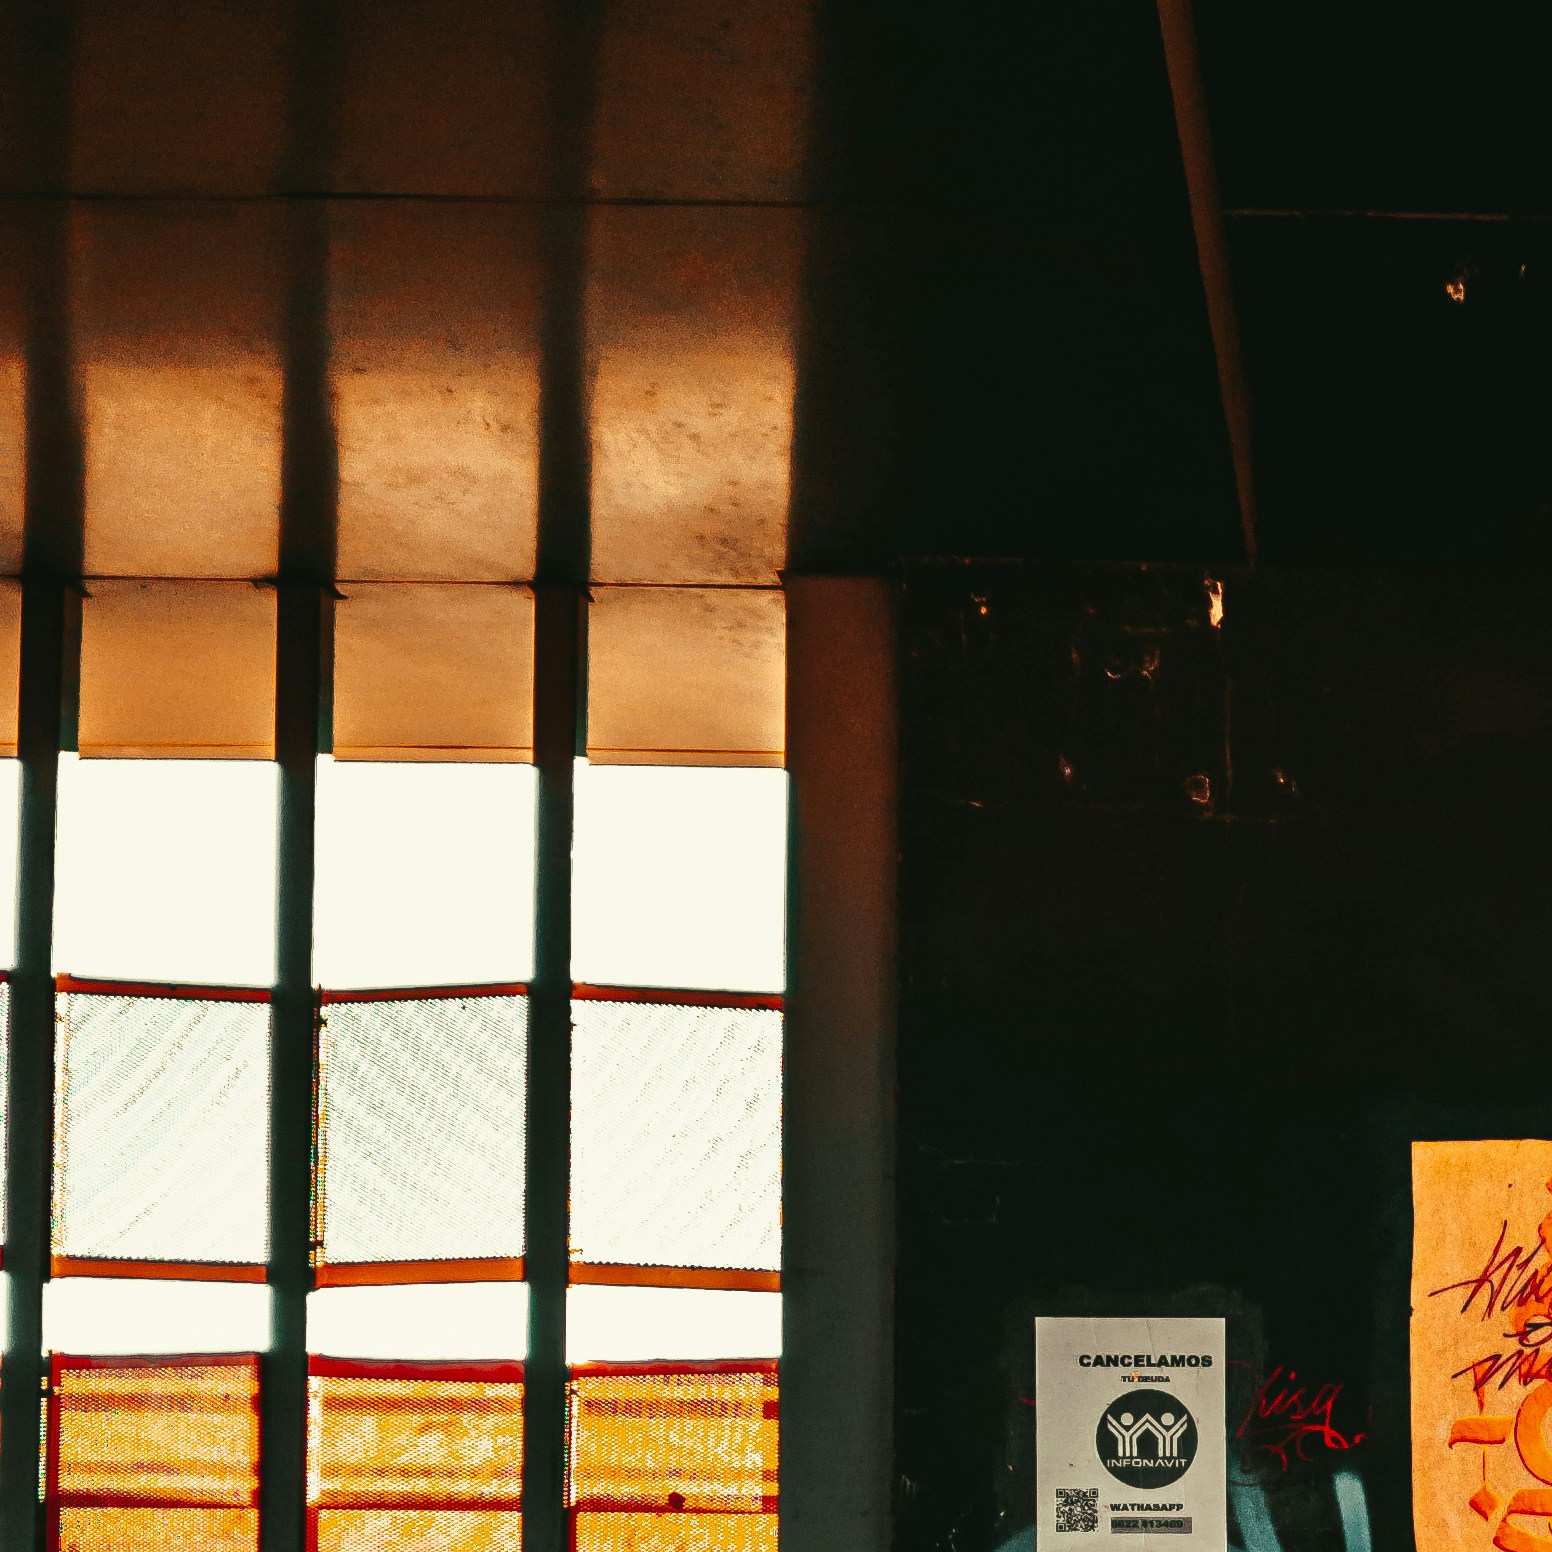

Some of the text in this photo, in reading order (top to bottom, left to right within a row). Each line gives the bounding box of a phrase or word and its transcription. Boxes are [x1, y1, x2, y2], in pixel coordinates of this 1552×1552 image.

[1078, 1354, 1213, 1368] CANCELAMOS
[1107, 1458, 1188, 1467] INFONAVIT
[1110, 1503, 1183, 1512] WATHASAPP
